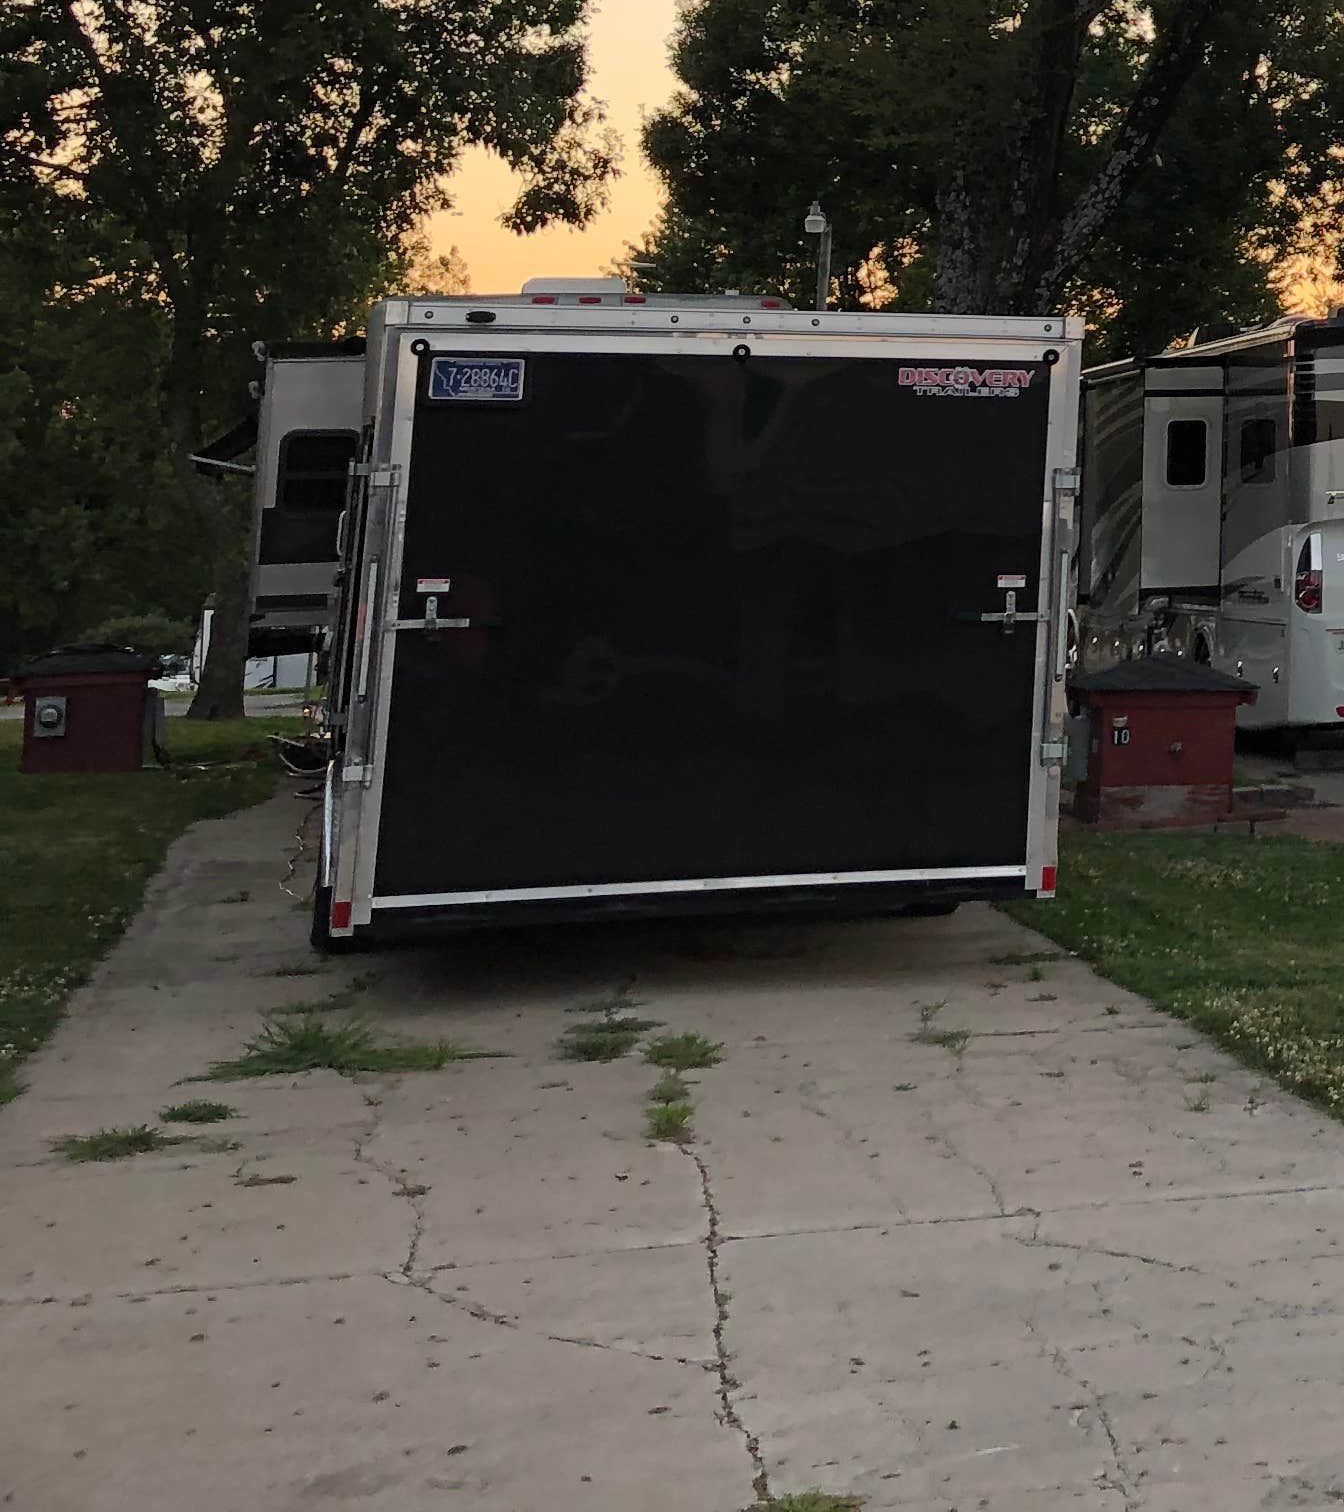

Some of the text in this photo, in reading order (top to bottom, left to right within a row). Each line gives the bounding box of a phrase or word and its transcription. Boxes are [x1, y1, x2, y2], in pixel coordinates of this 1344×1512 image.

[898, 367, 1035, 387] DISCOVERY
[912, 386, 1020, 397] TRAILERS
[1113, 729, 1130, 745] 10
